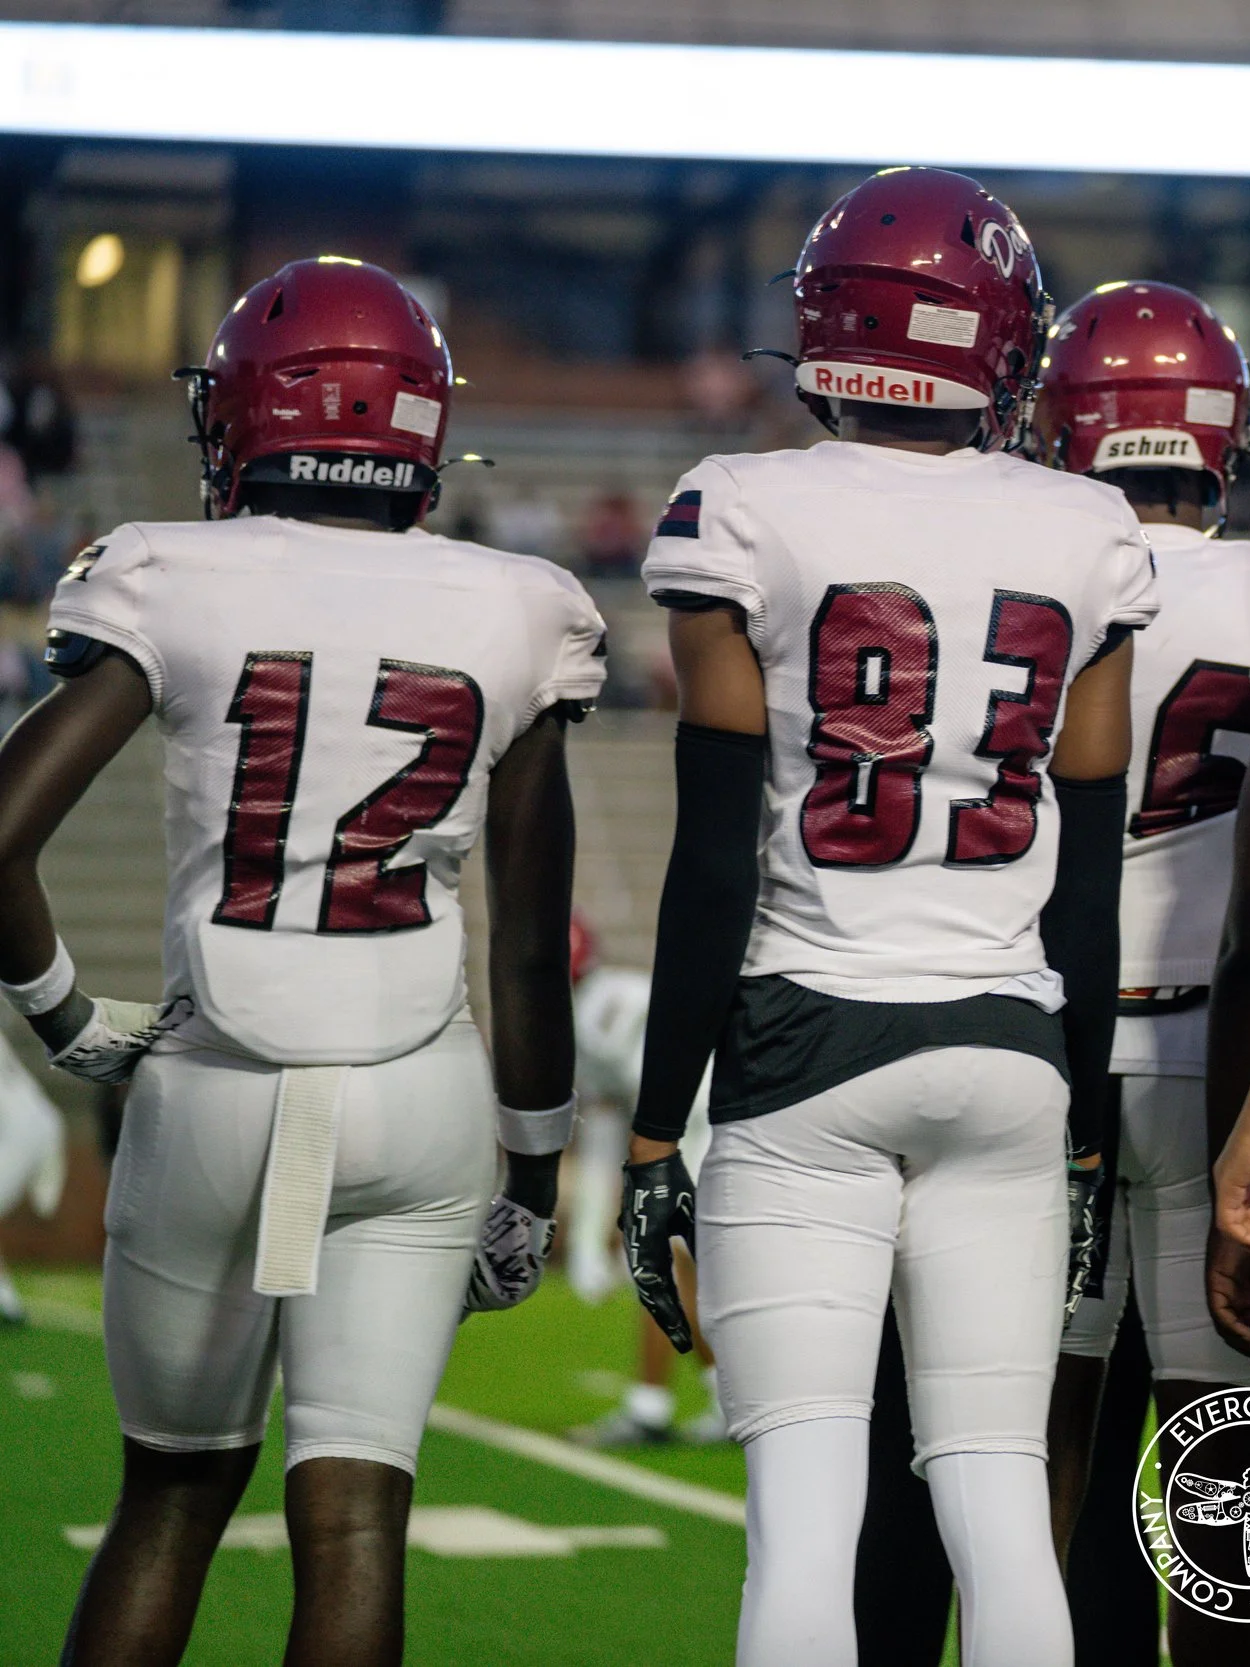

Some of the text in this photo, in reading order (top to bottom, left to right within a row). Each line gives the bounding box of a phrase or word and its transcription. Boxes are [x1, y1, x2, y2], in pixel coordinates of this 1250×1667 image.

[815, 367, 936, 405] Riddell
[1108, 435, 1190, 458] schutt
[289, 454, 416, 488] Riddell
[800, 581, 1074, 869] 83
[210, 650, 485, 934] 12
